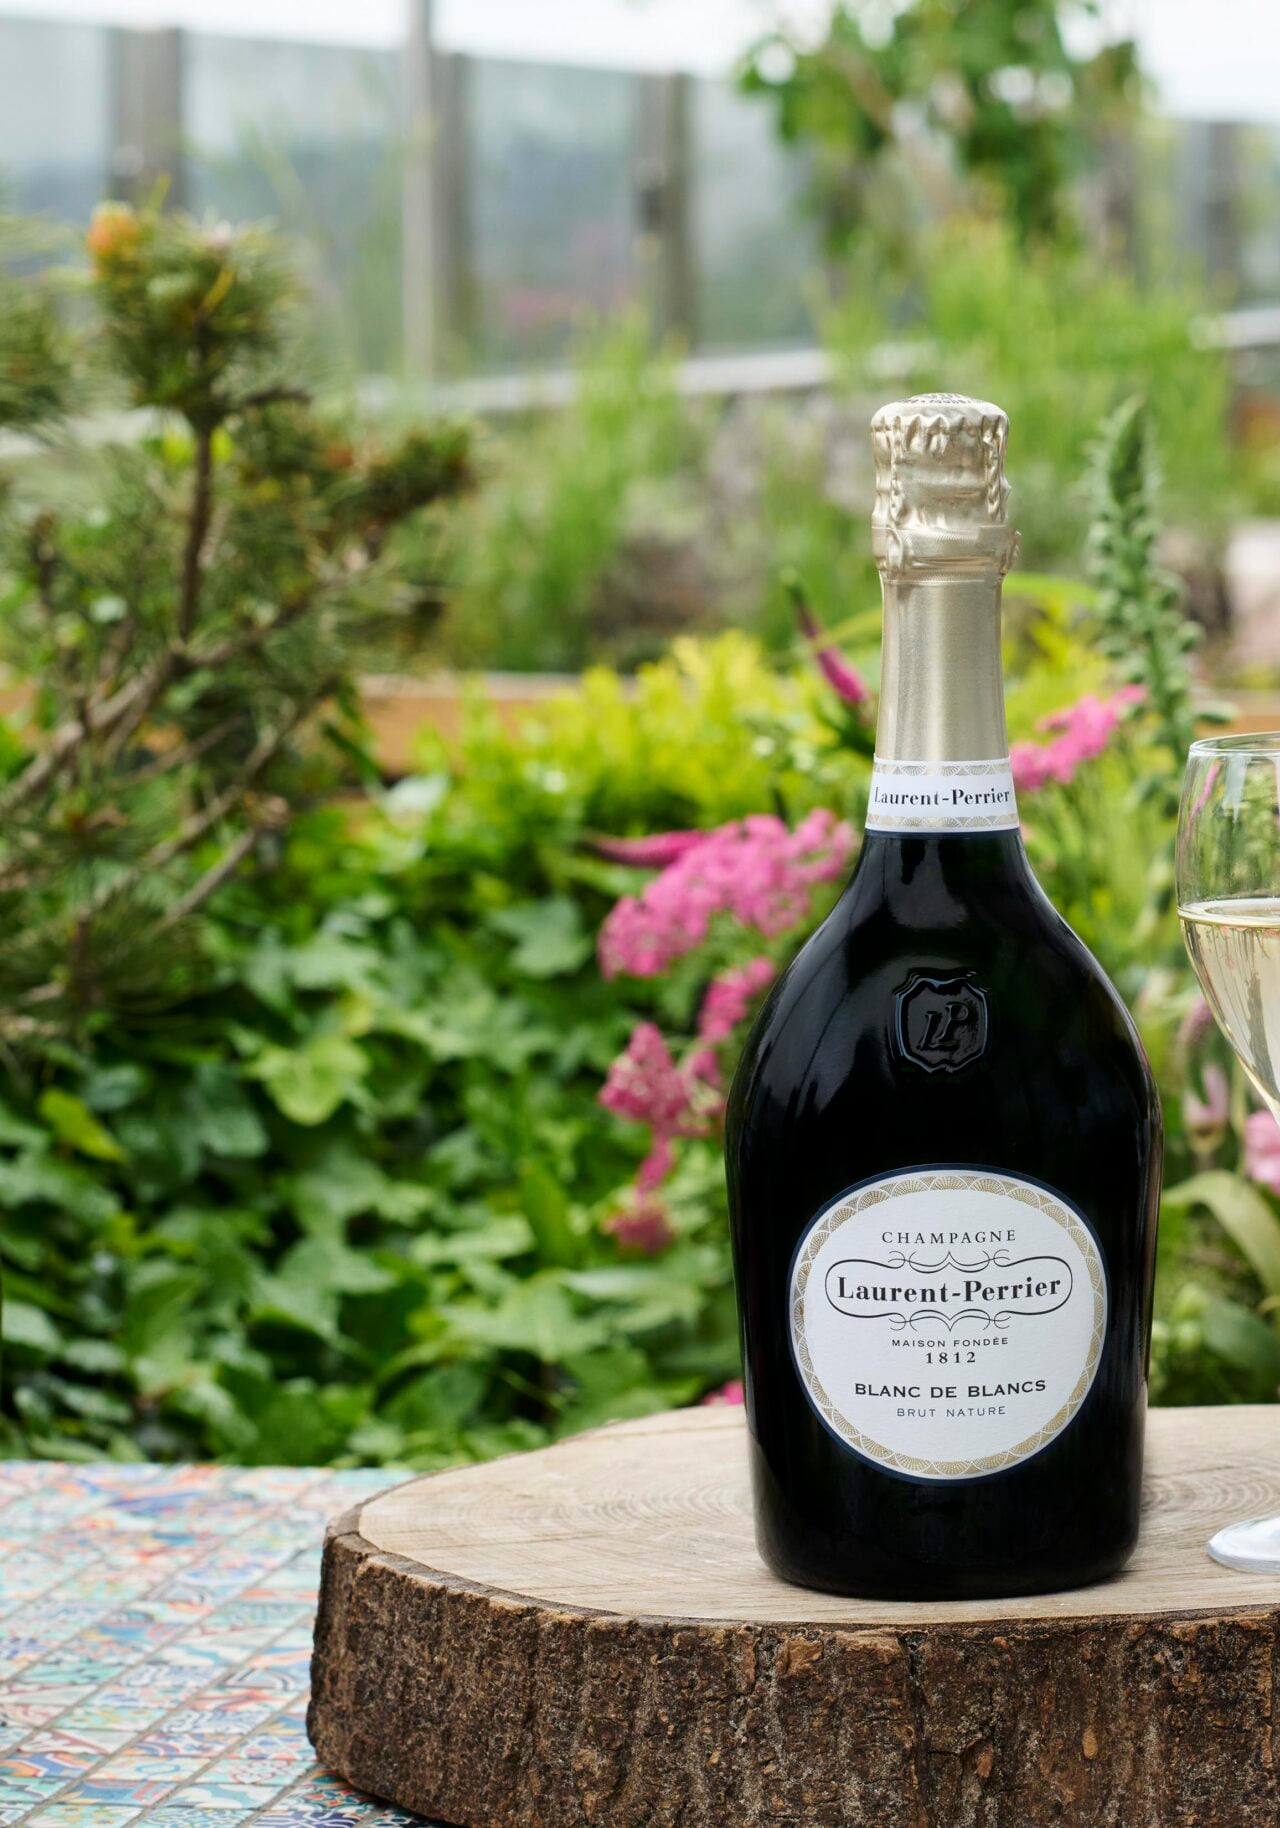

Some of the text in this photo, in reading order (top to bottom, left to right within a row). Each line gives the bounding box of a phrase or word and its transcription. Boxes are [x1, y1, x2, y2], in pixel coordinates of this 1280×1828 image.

[873, 786, 1010, 806] Laurent-Perrier
[881, 1229, 1016, 1244] CHAMPAGNE
[837, 1276, 1061, 1303] Laurent-Perrier
[891, 1336, 1009, 1348] MAISON FONDÉE
[926, 1351, 976, 1365] 1812
[854, 1379, 1047, 1399] BLANC DE BLANCS
[897, 1405, 1006, 1418] BRUT NATURE
